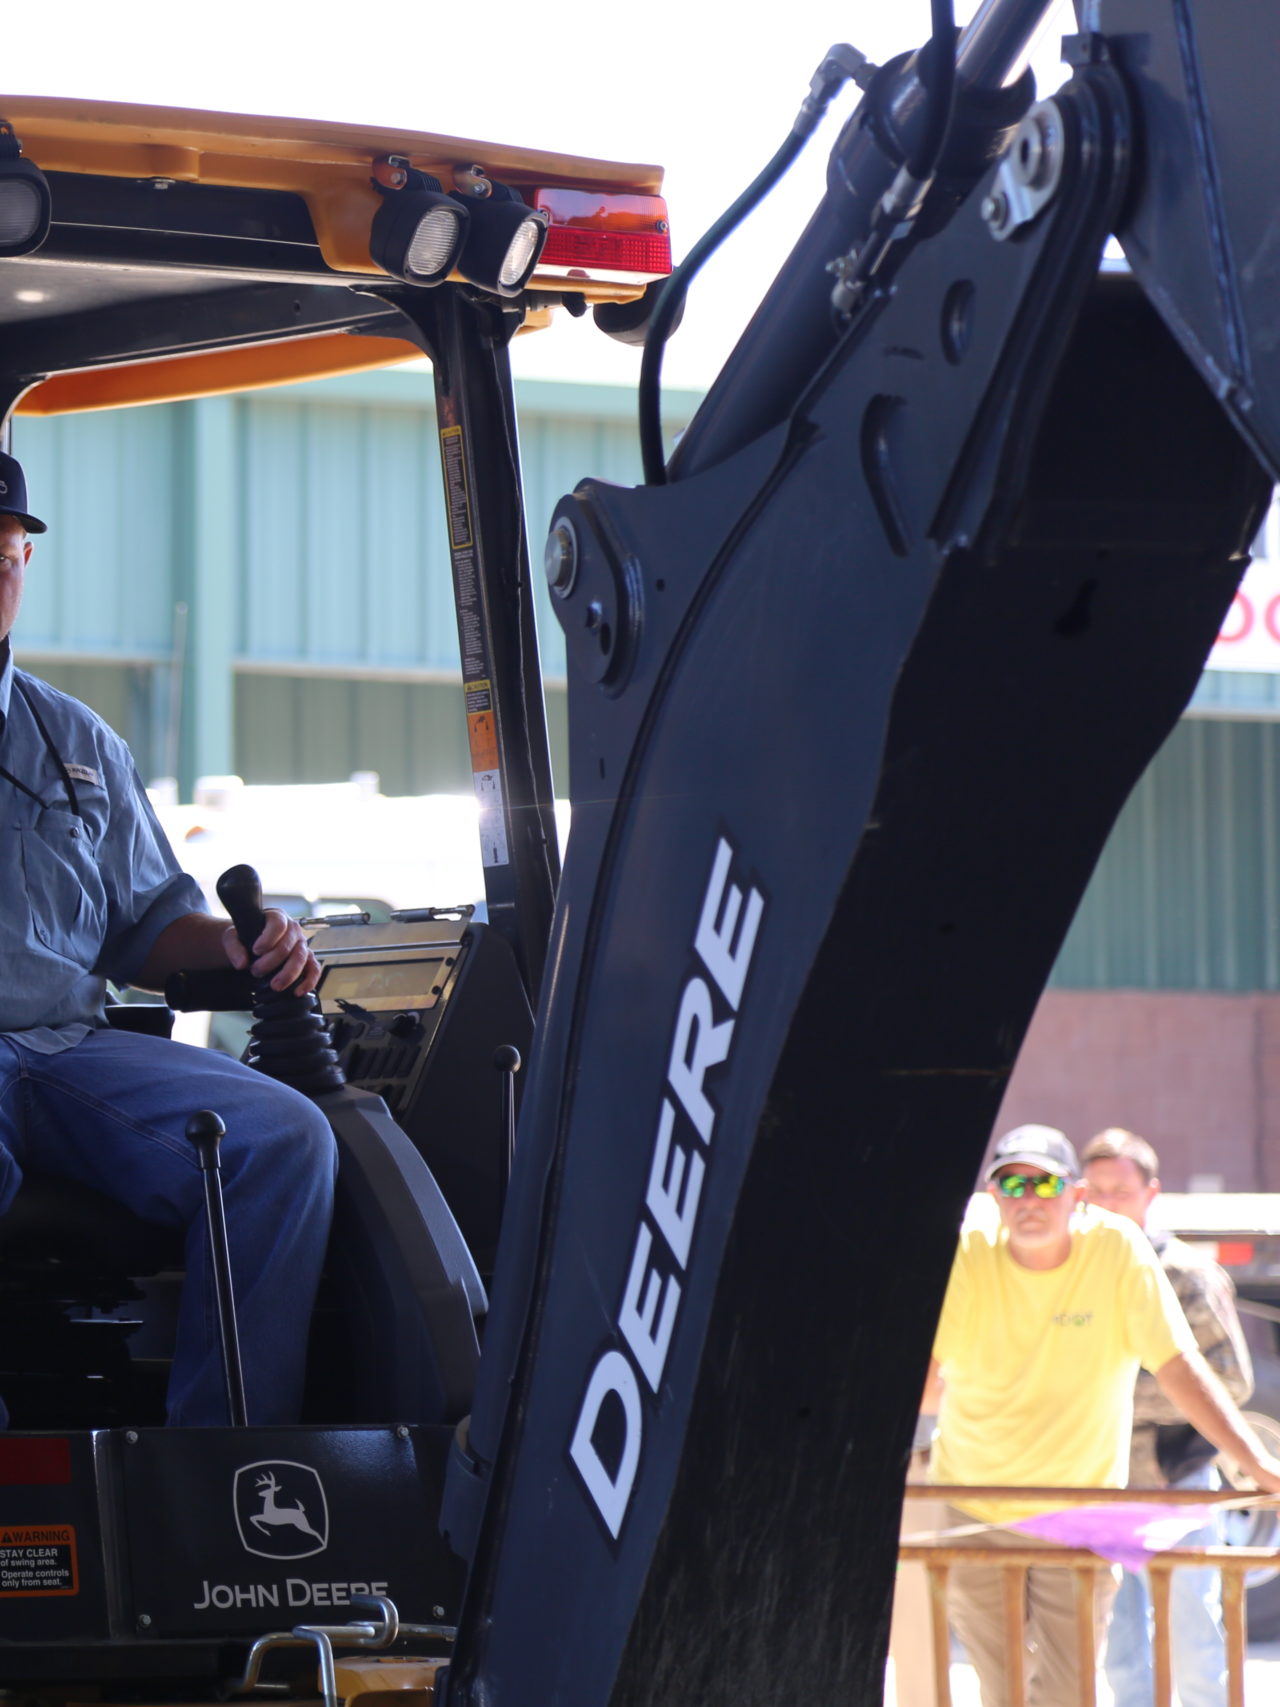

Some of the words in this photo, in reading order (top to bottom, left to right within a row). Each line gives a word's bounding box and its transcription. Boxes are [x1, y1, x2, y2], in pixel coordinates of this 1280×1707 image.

[570, 838, 764, 1540] DEERE
[13, 1530, 70, 1542] WARNING
[0, 1549, 23, 1558] STAY
[26, 1548, 58, 1557] CLEAR
[0, 1559, 9, 1567] of
[10, 1558, 36, 1568] swing
[37, 1558, 57, 1566] area.
[1, 1569, 33, 1579] Operate
[35, 1568, 69, 1577] controls
[1, 1579, 20, 1588] only
[21, 1578, 41, 1586] from
[42, 1577, 62, 1586] seat.
[194, 1580, 279, 1609] JOHN
